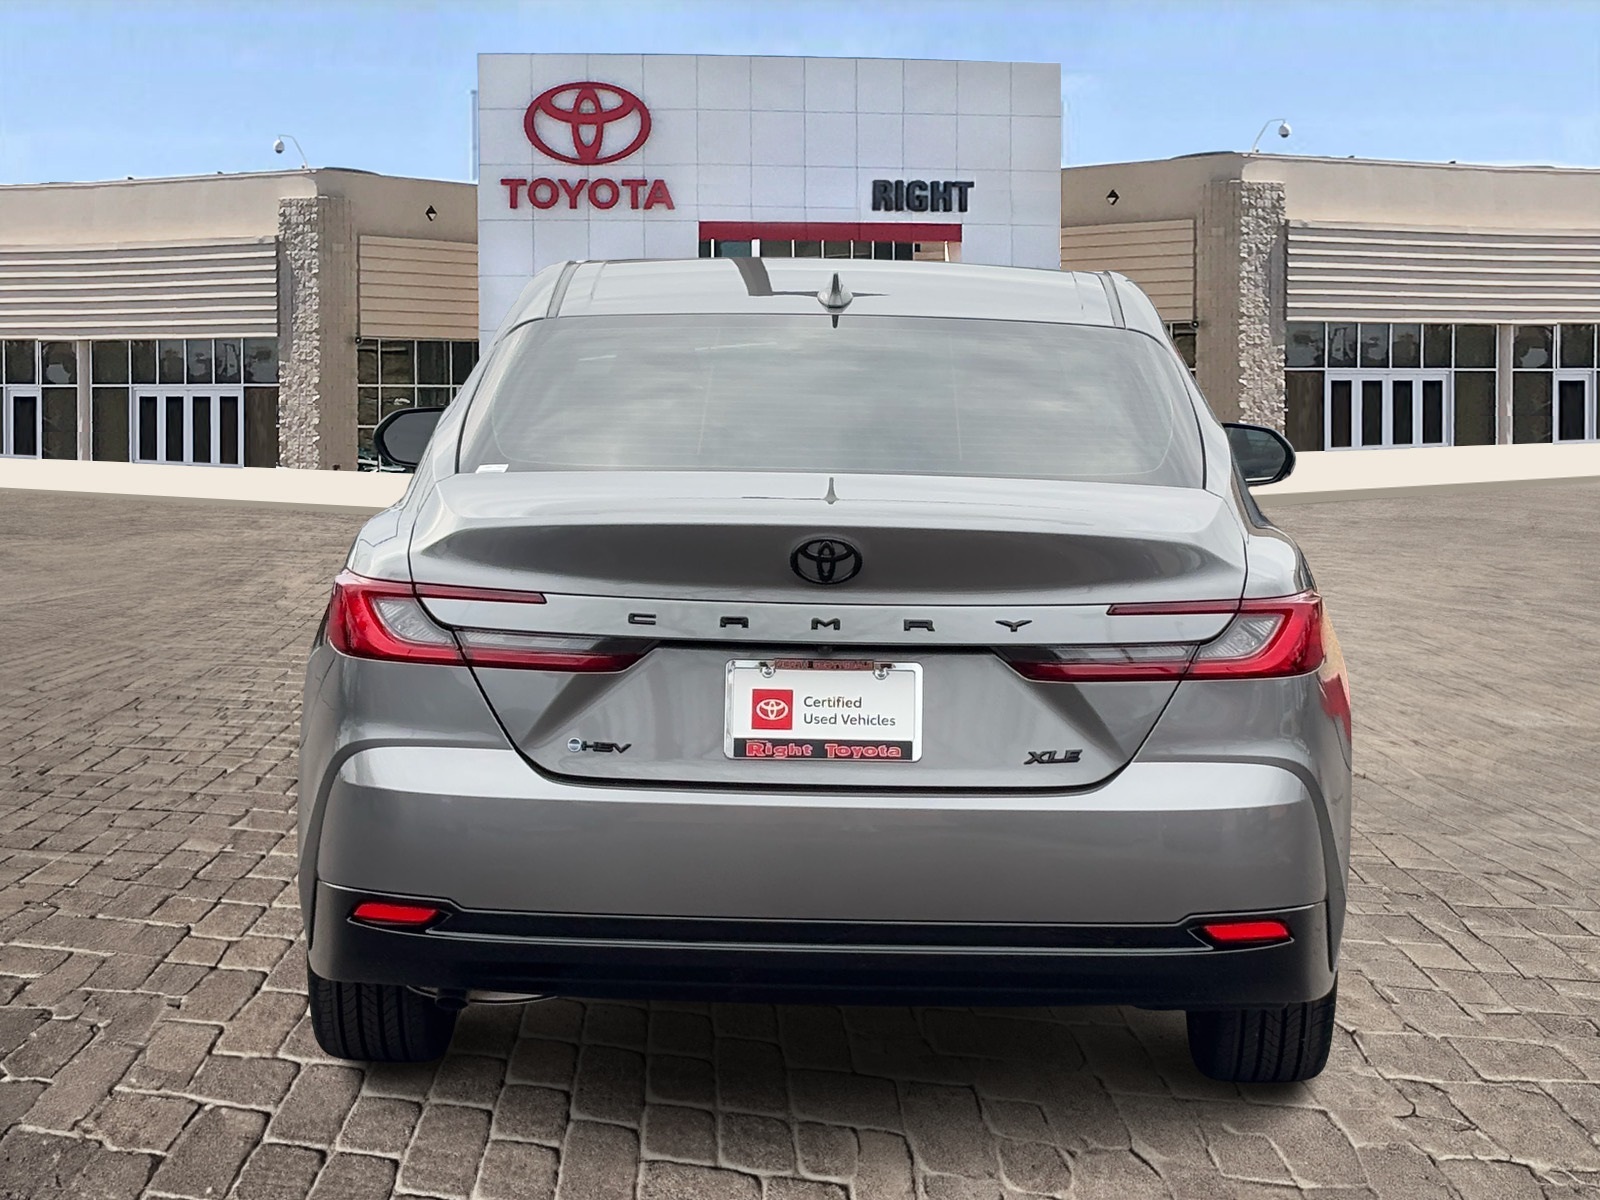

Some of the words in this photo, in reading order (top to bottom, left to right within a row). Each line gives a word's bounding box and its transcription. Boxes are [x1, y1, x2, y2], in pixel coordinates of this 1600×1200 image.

[500, 177, 676, 210] TOYOTA
[872, 179, 975, 212] RIGHT
[627, 612, 1034, 633] CAMRY
[803, 696, 863, 709] Certified
[803, 713, 838, 725] Used
[841, 713, 896, 727] Vehicles
[746, 741, 813, 758] Right
[825, 743, 902, 758] Toyota
[1023, 749, 1083, 765] XLE
